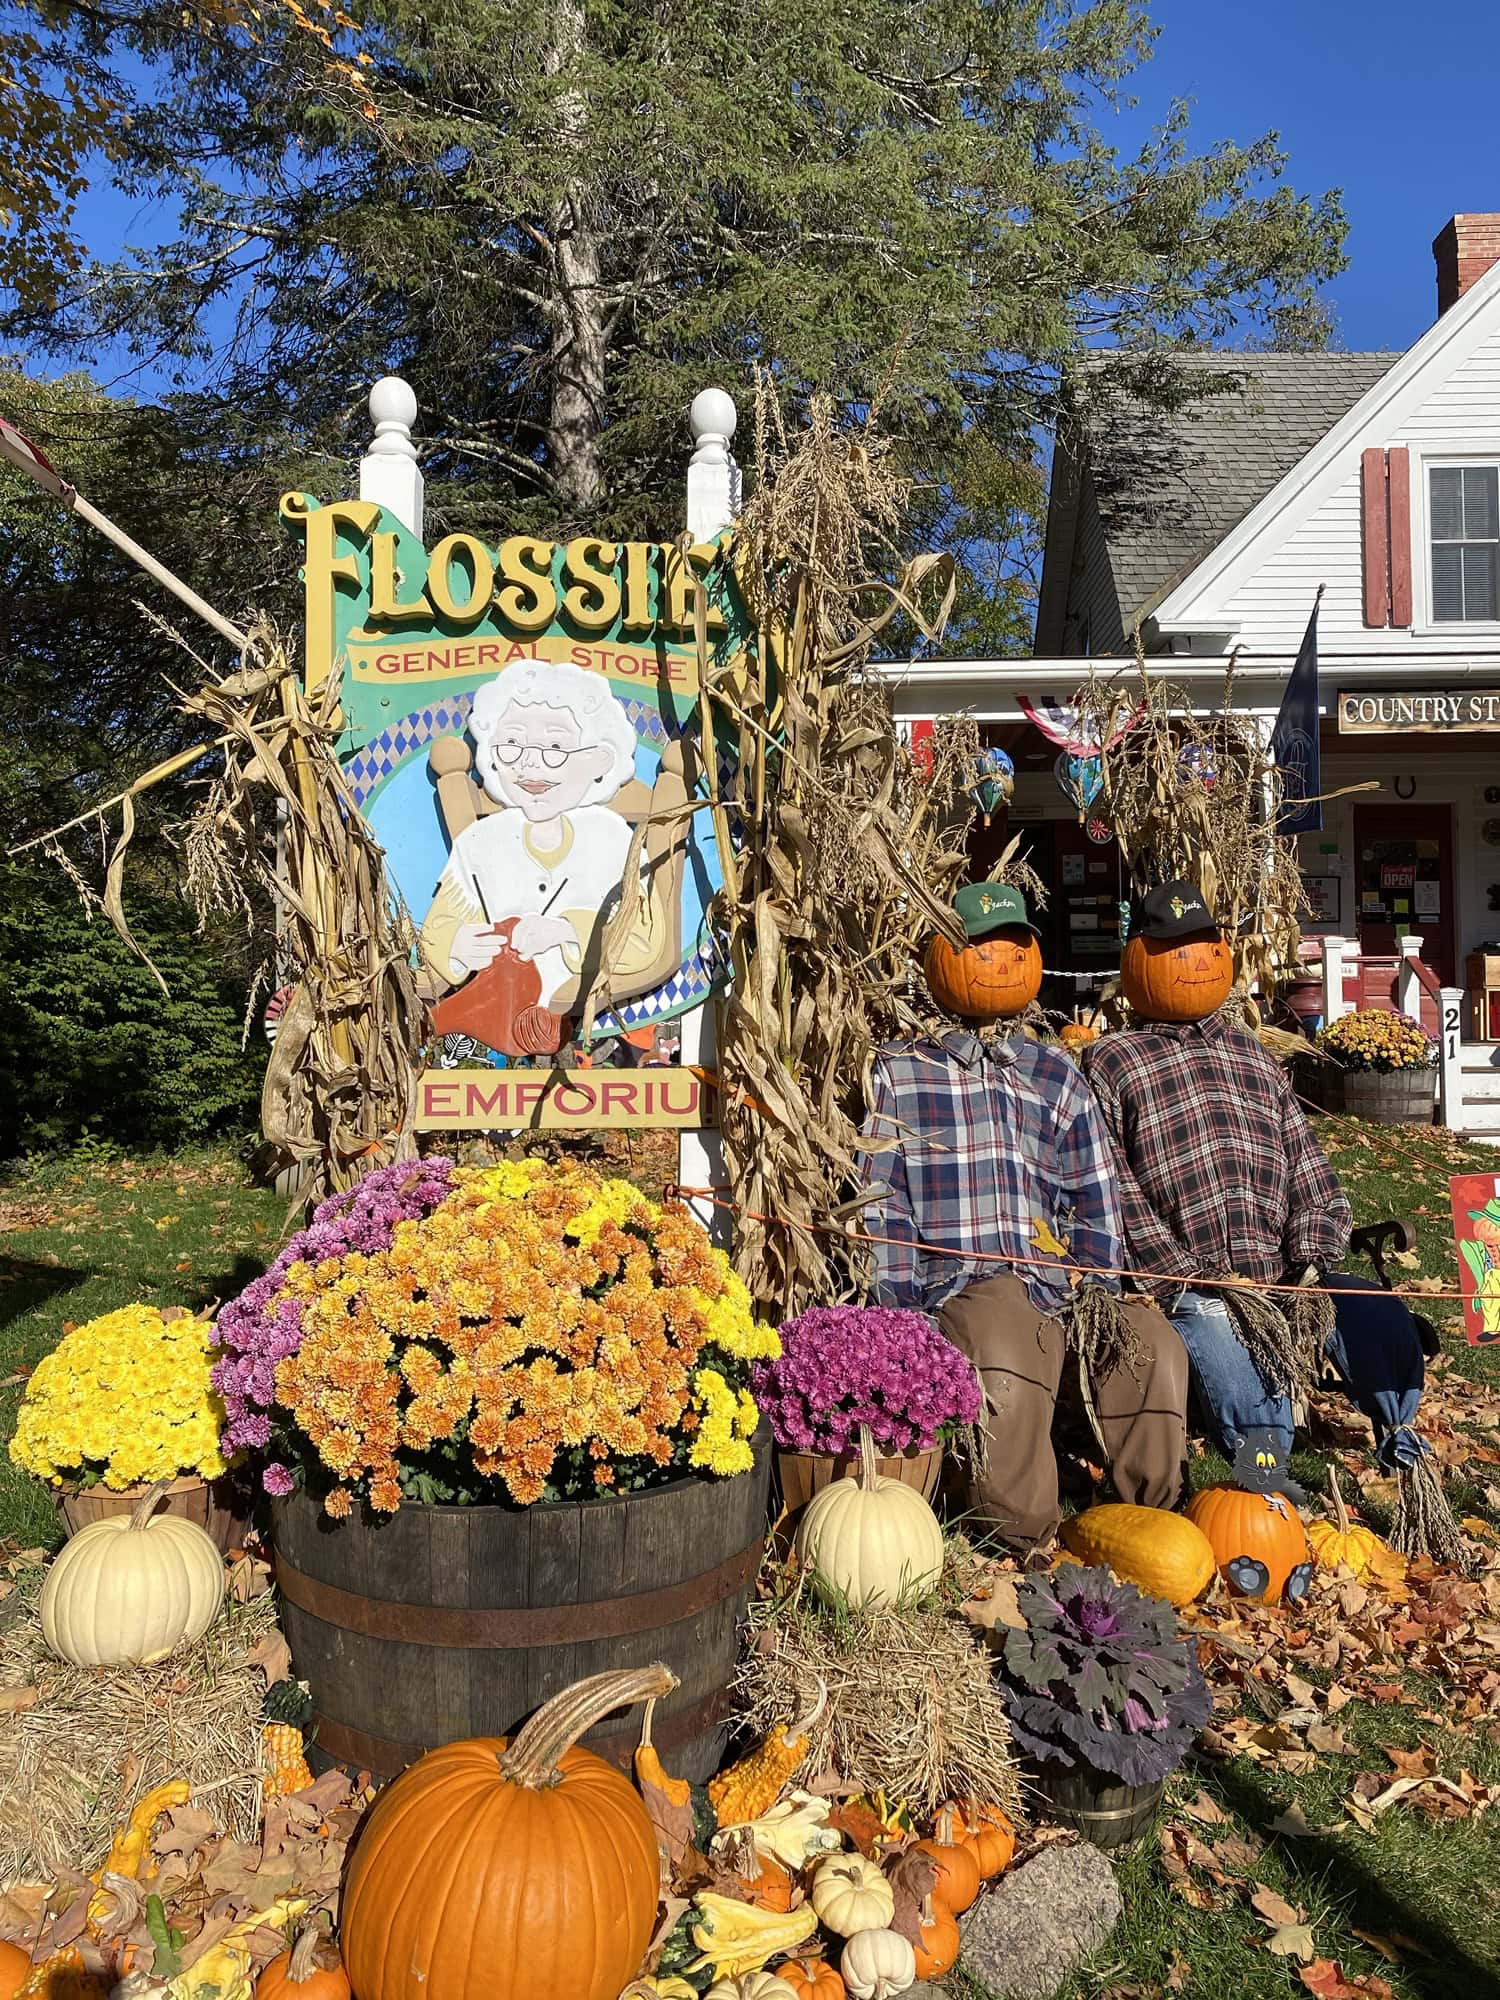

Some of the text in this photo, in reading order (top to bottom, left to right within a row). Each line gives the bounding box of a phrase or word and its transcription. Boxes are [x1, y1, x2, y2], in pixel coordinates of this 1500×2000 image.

[374, 642, 687, 682] GENERAL STORE
[1344, 697, 1463, 722] COUNTRY
[1384, 874, 1413, 886] OPEN
[423, 1082, 717, 1118] EMPORIU
